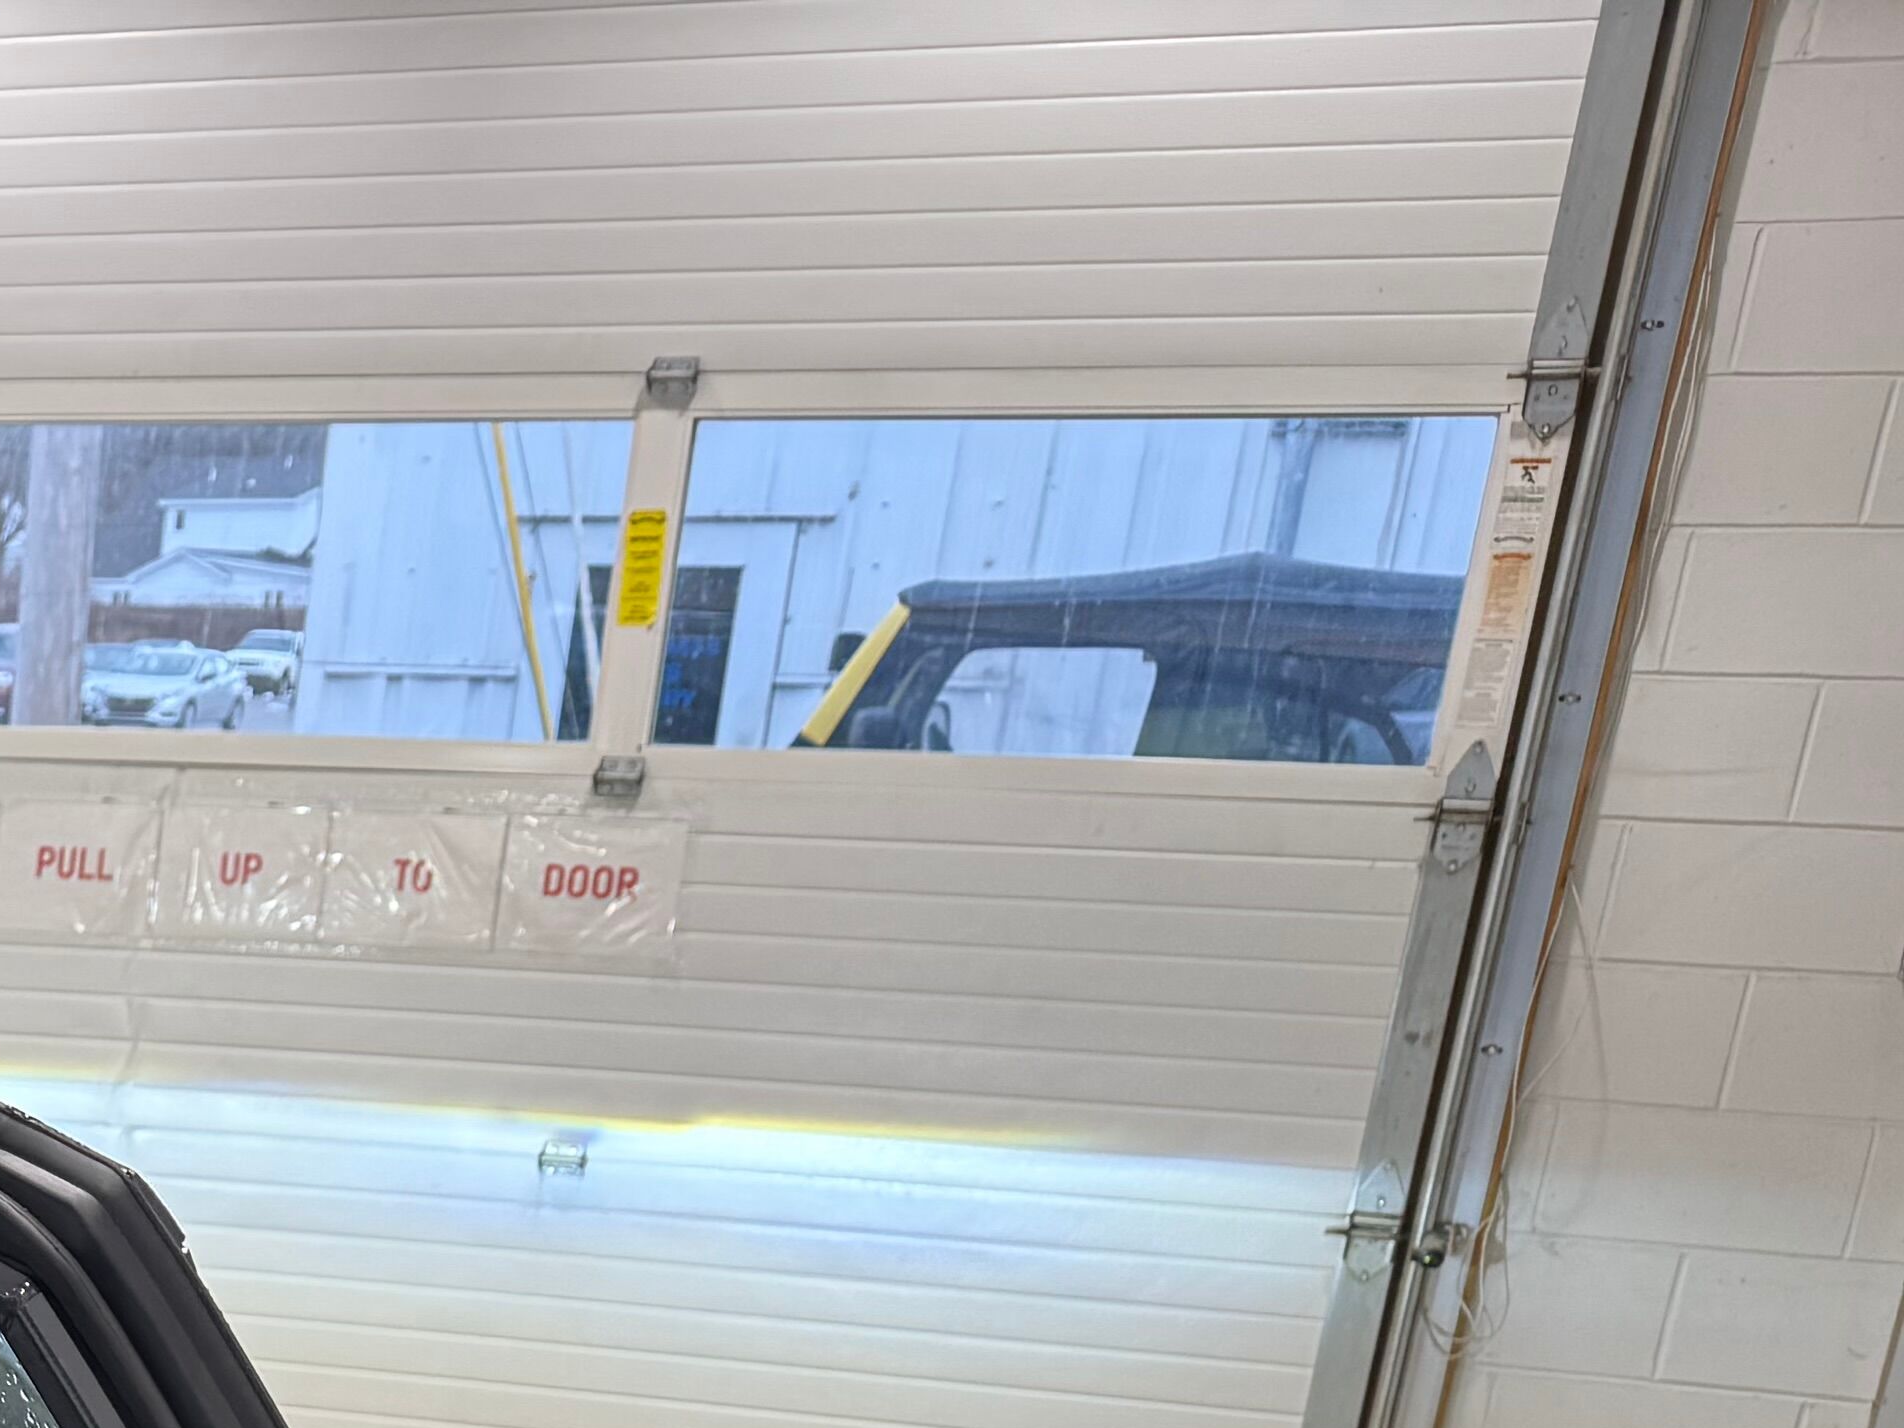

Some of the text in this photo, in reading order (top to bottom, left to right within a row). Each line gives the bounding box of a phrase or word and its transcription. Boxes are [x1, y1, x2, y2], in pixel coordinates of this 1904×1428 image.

[35, 845, 113, 884] PULL
[219, 851, 264, 886] UP
[392, 857, 433, 894] TO
[542, 861, 640, 902] DOOR
